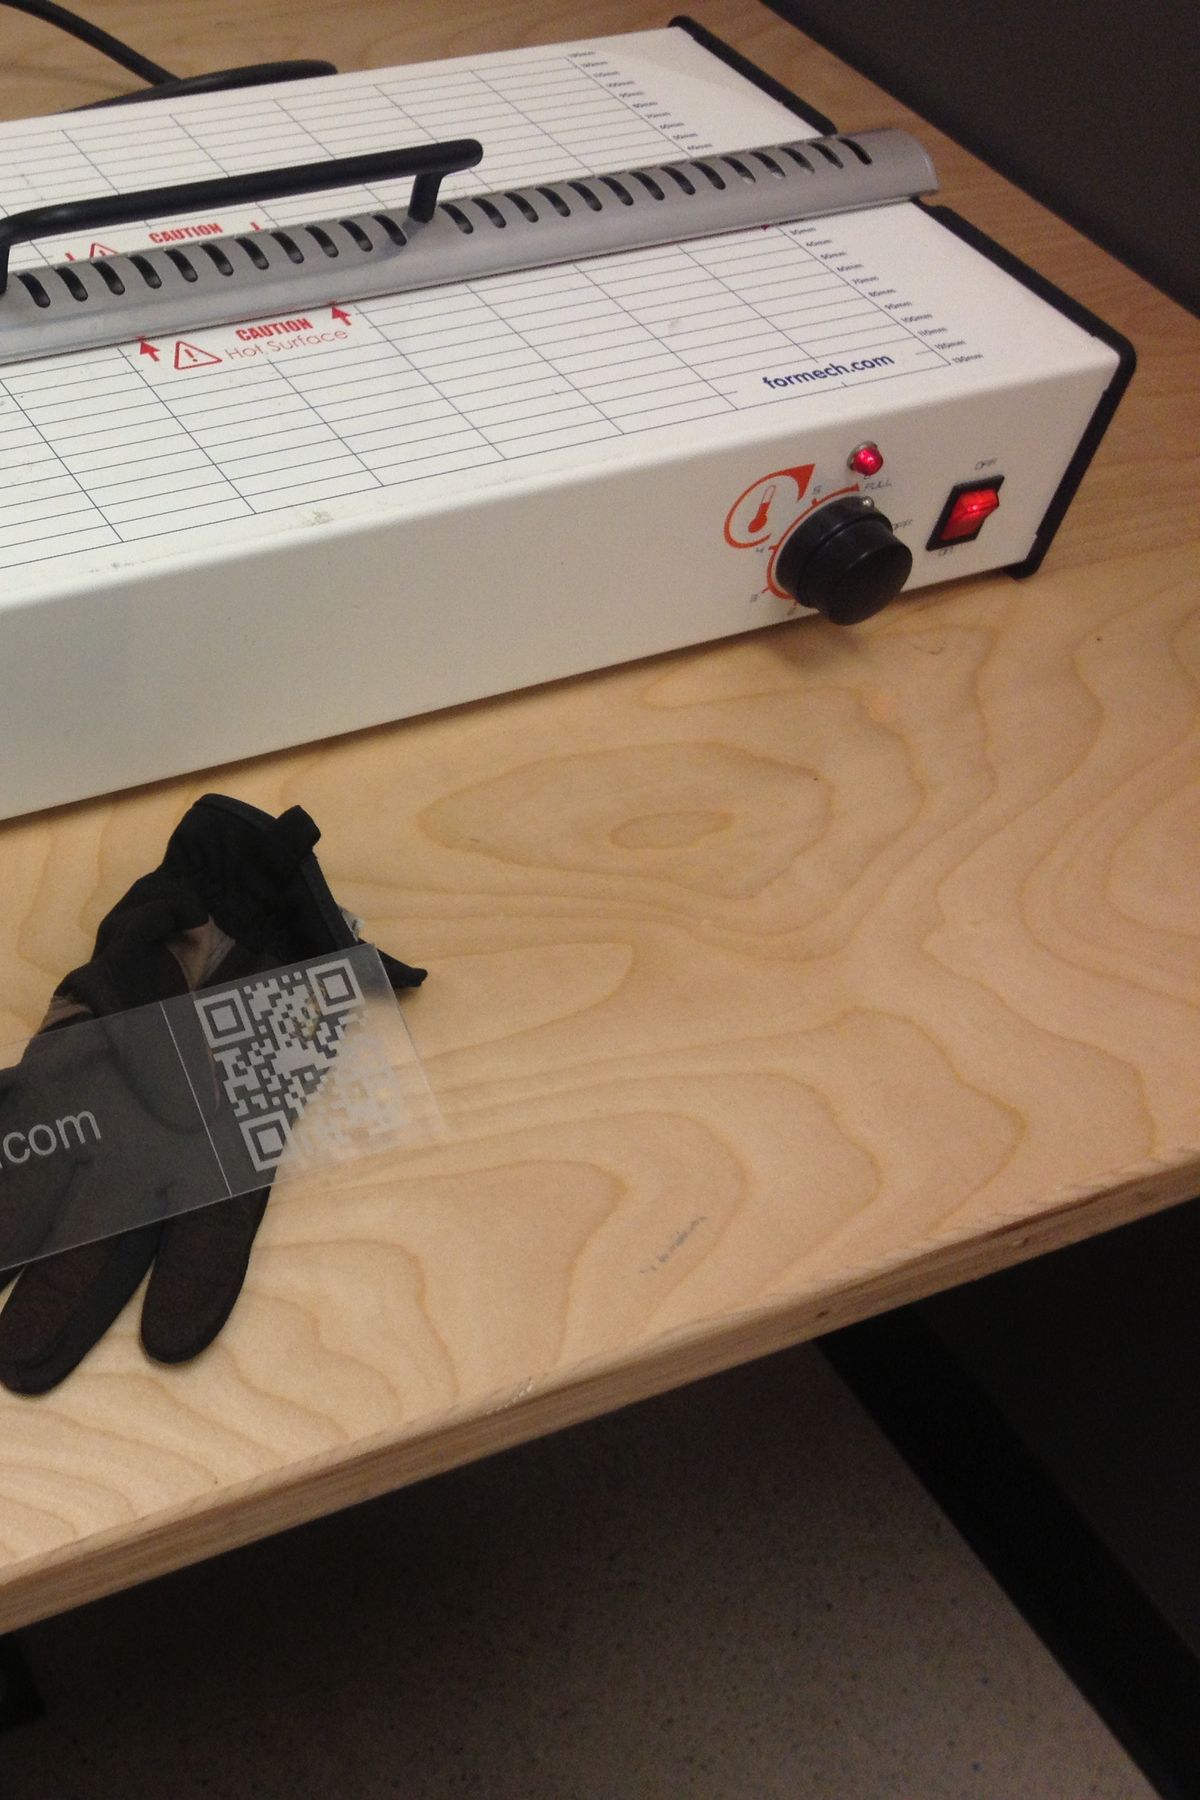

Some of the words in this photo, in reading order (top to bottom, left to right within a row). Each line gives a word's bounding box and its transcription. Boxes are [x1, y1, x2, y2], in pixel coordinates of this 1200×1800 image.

[148, 223, 224, 244] CAUTION
[234, 318, 314, 342] CAUTION
[225, 342, 264, 361] Hot
[266, 328, 349, 353] Surface
[762, 355, 896, 390] formech.com
